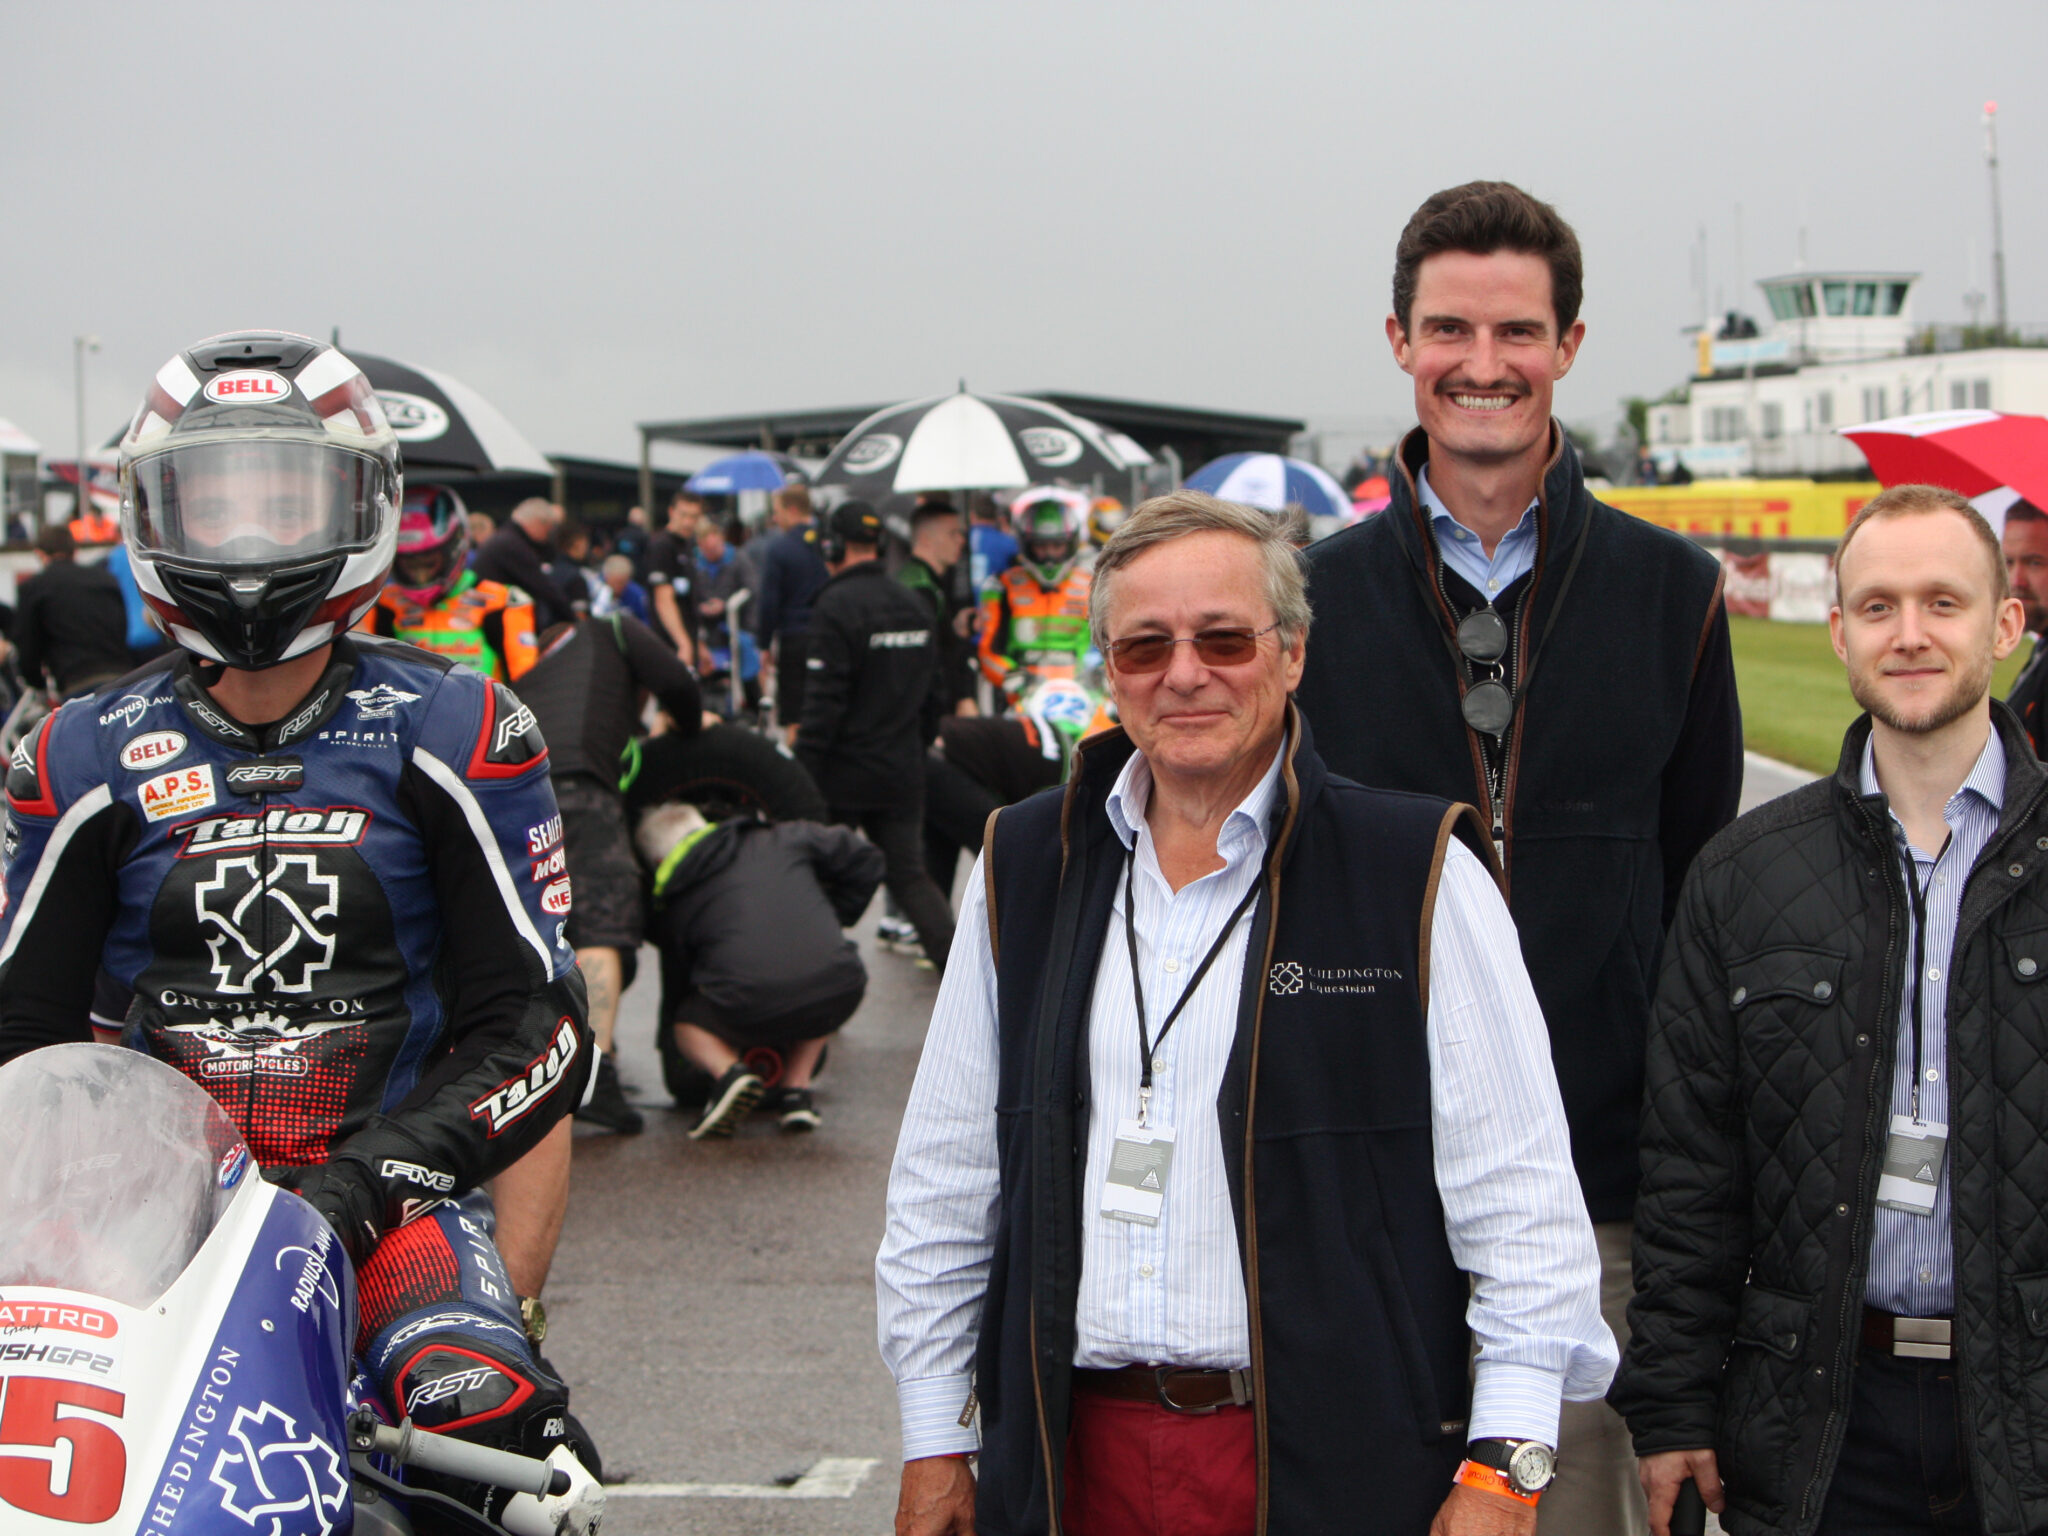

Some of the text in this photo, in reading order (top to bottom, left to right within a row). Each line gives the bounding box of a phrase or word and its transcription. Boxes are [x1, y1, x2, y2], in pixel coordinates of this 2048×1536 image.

[217, 379, 281, 395] BELL
[99, 696, 174, 726] RADIUS LAW
[188, 700, 244, 737] RST
[278, 689, 330, 745] RST
[1043, 693, 1087, 719] 22
[318, 730, 399, 743] SPIRIT
[495, 704, 538, 753] RS
[129, 738, 178, 763] BELL
[144, 771, 209, 804] A.P.S.
[226, 765, 304, 782] RST
[175, 810, 366, 854] Talon
[1308, 967, 1403, 980] CHEDINGTON
[1309, 981, 1376, 995] Equestrian
[207, 1057, 300, 1073] MOTORCYCLES
[473, 1021, 578, 1132] Talon
[290, 1227, 333, 1313] RADIUS LAW
[406, 1366, 502, 1414] RST
